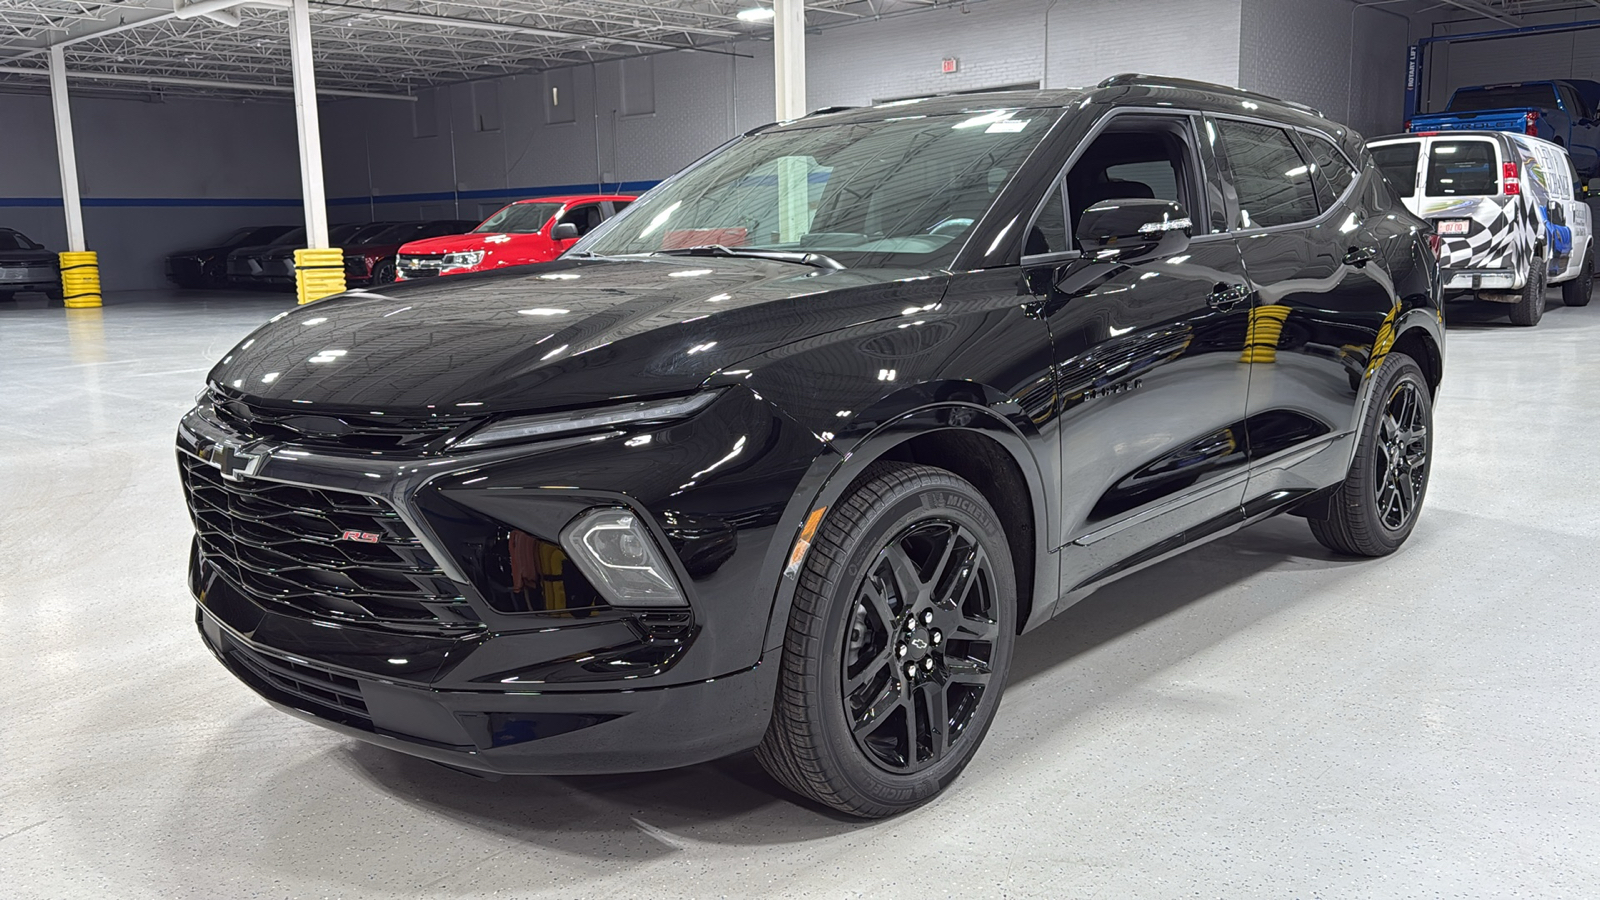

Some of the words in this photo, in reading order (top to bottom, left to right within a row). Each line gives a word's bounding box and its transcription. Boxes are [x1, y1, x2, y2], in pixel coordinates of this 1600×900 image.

[1408, 61, 1416, 87] ROTARY
[947, 495, 998, 537] MICHELIN
[342, 530, 380, 543] RS
